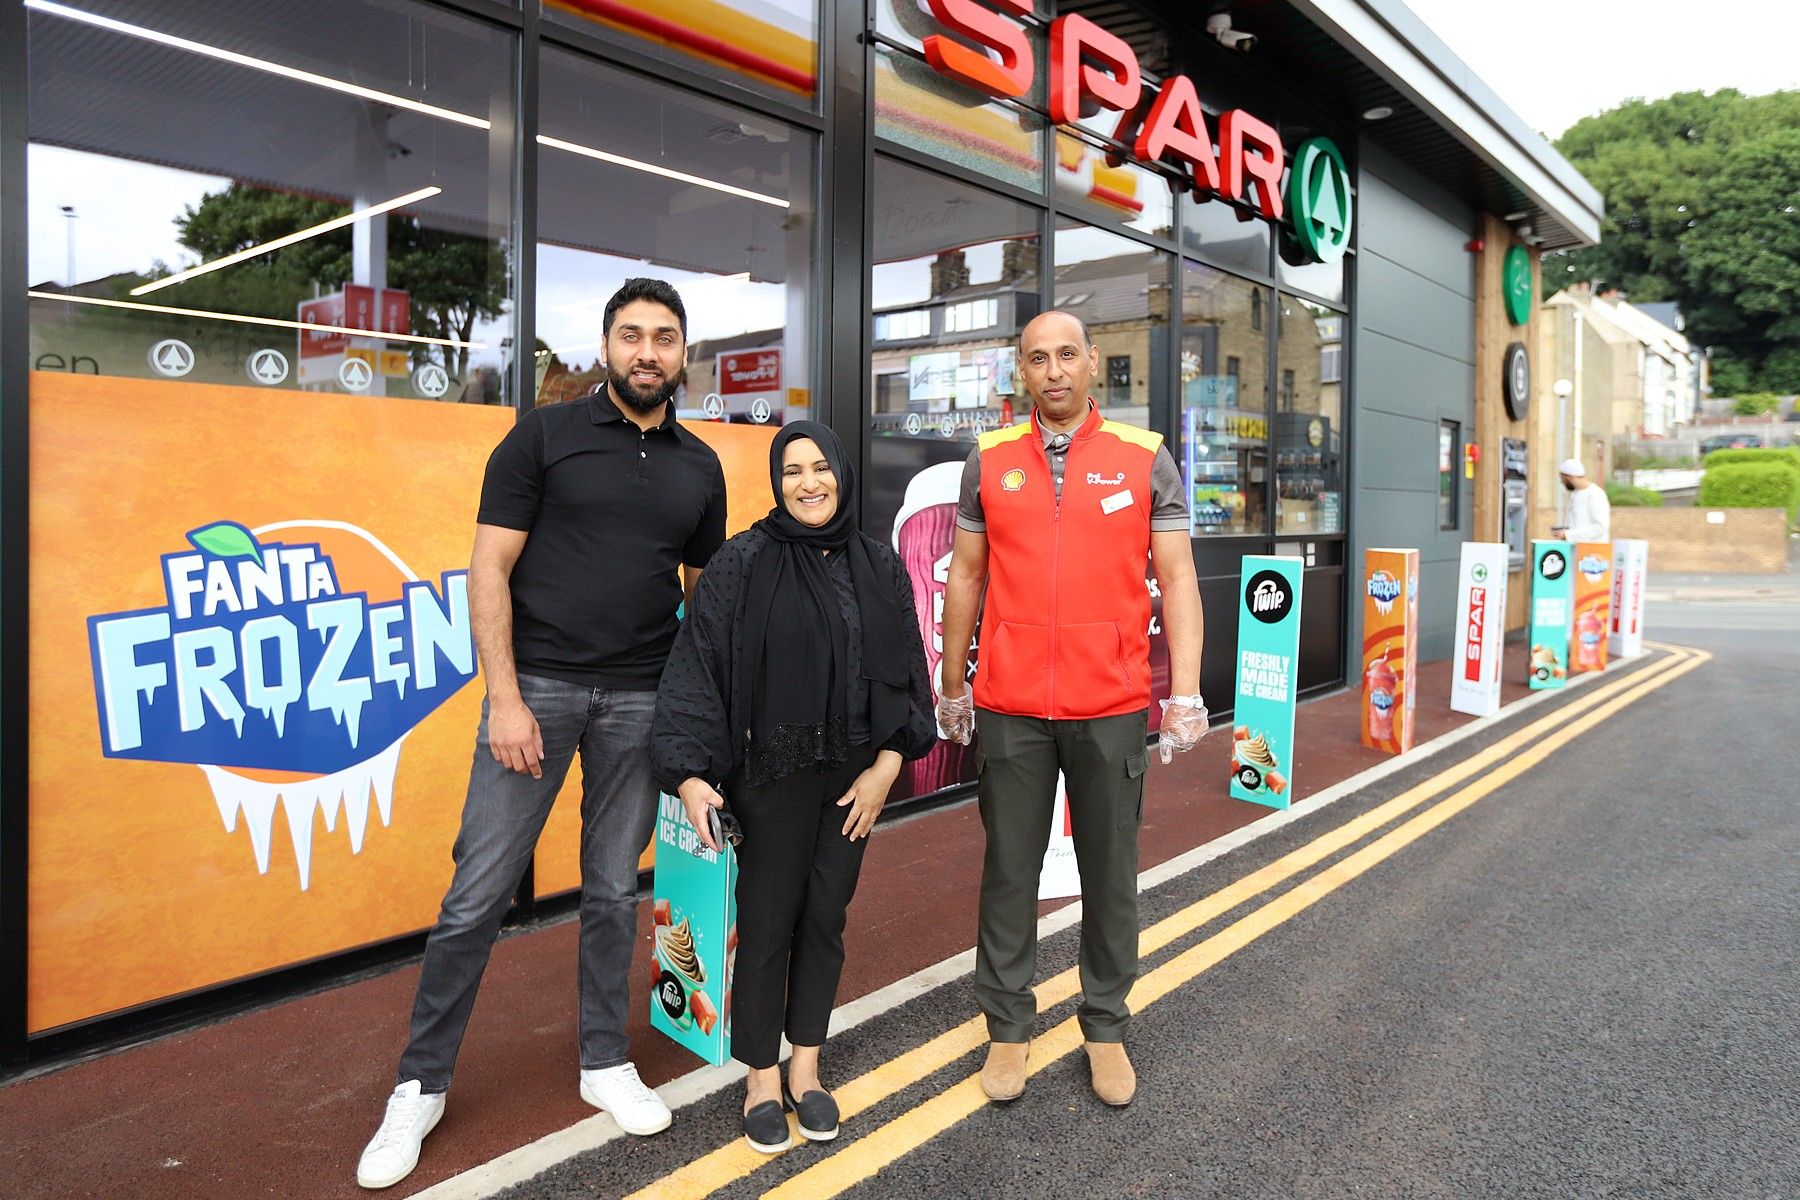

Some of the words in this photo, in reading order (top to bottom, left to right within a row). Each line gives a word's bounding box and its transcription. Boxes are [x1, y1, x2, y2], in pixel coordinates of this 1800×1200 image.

[921, 0, 1284, 220] SPAR
[166, 547, 336, 619] FANTA
[1467, 586, 1486, 662] SPAR
[96, 574, 475, 752] FROZEN
[1240, 667, 1288, 689] MADE
[1241, 650, 1290, 673] FRESHLY
[1239, 681, 1254, 697] ICE
[1255, 685, 1288, 703] CREAM
[660, 818, 676, 846] ICE
